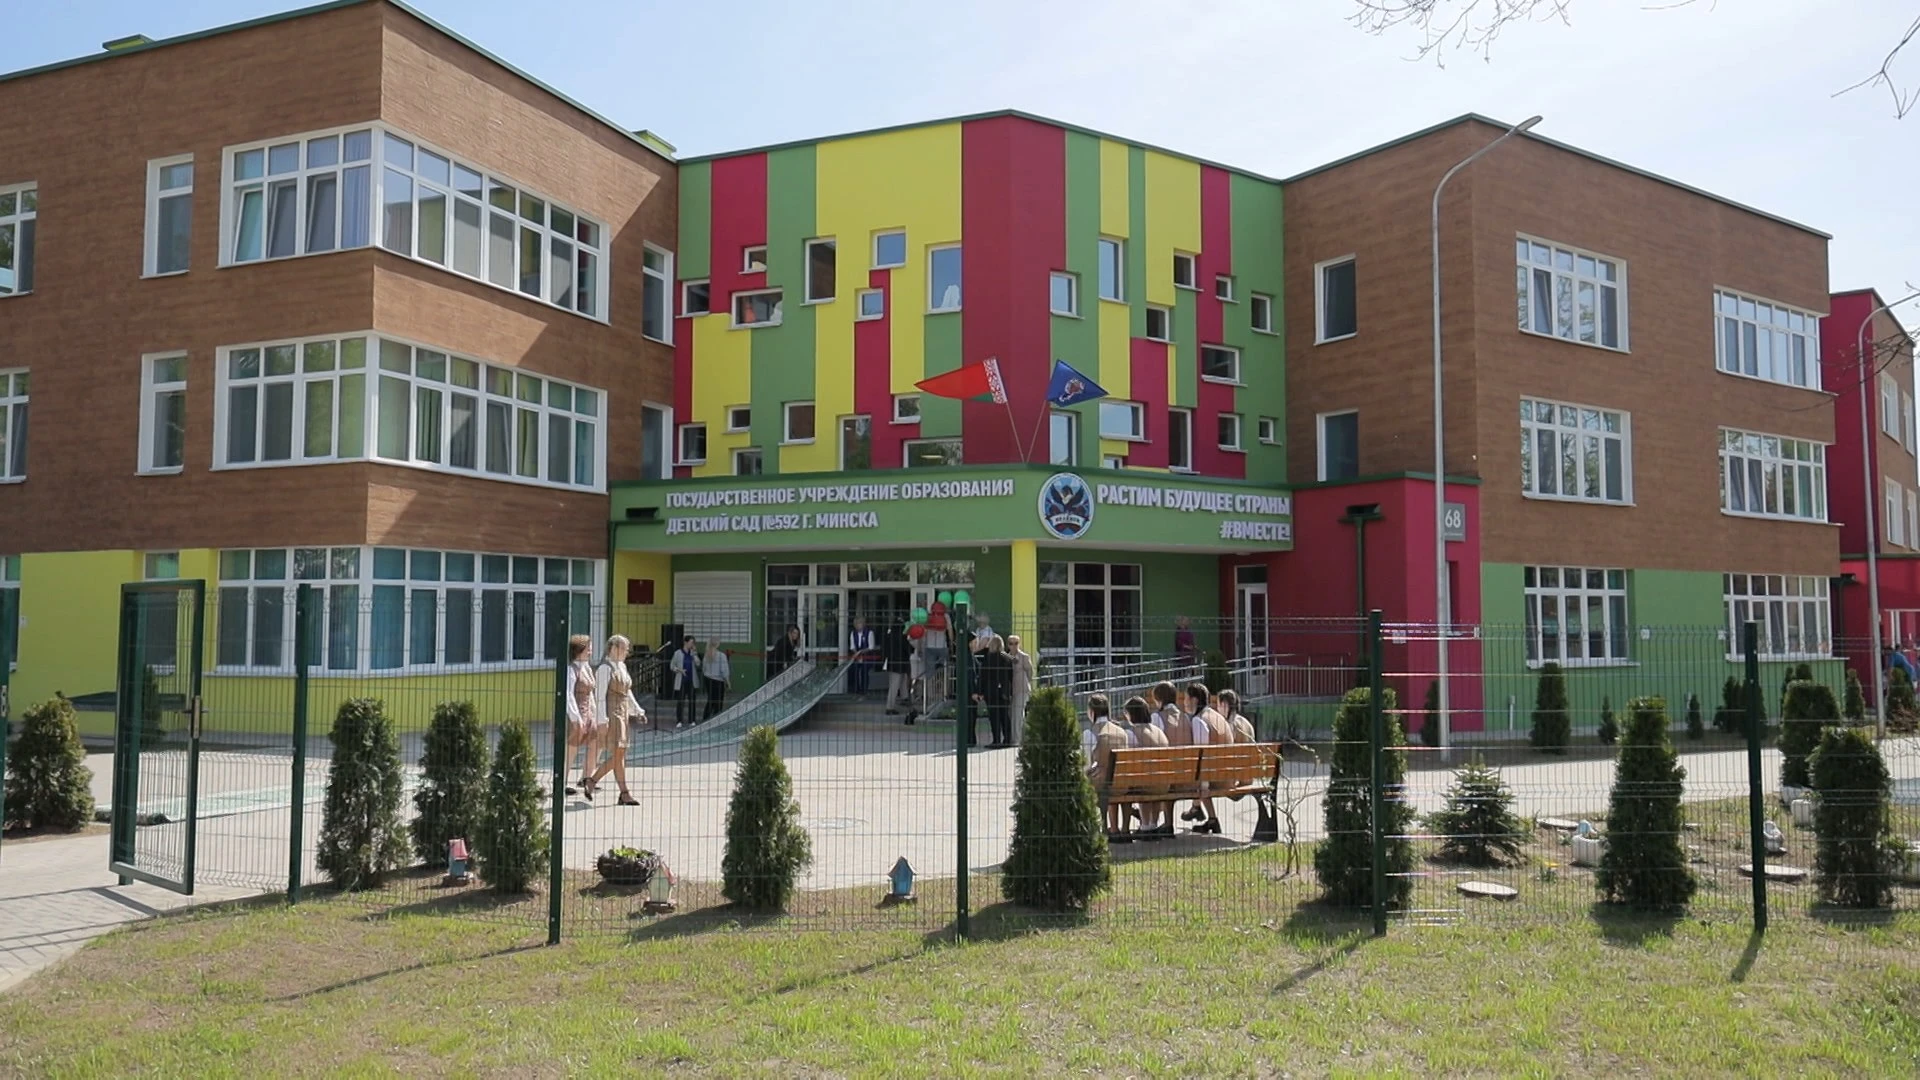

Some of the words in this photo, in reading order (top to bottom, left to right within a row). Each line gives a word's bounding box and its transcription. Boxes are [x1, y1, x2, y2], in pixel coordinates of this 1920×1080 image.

[666, 488, 795, 508] ГОСУДАРСТВЕННОЕ
[799, 484, 899, 503] УЧРЕЖДЕНИЕ
[901, 479, 1014, 500] ОБРАЗОВАНИЯ
[1096, 484, 1162, 507] РАСТИМ
[1164, 489, 1233, 513] БУДУЩЕЕ
[1234, 494, 1290, 515] СТРАНЫ
[666, 513, 729, 535] ДЕТСКИЙ
[731, 515, 761, 533] САД
[763, 514, 800, 531] №592
[802, 513, 812, 529] Г.
[815, 511, 879, 530] МИНСКА
[1219, 520, 1291, 541] #ВМЕСТЕ!
[1445, 509, 1461, 528] 68
